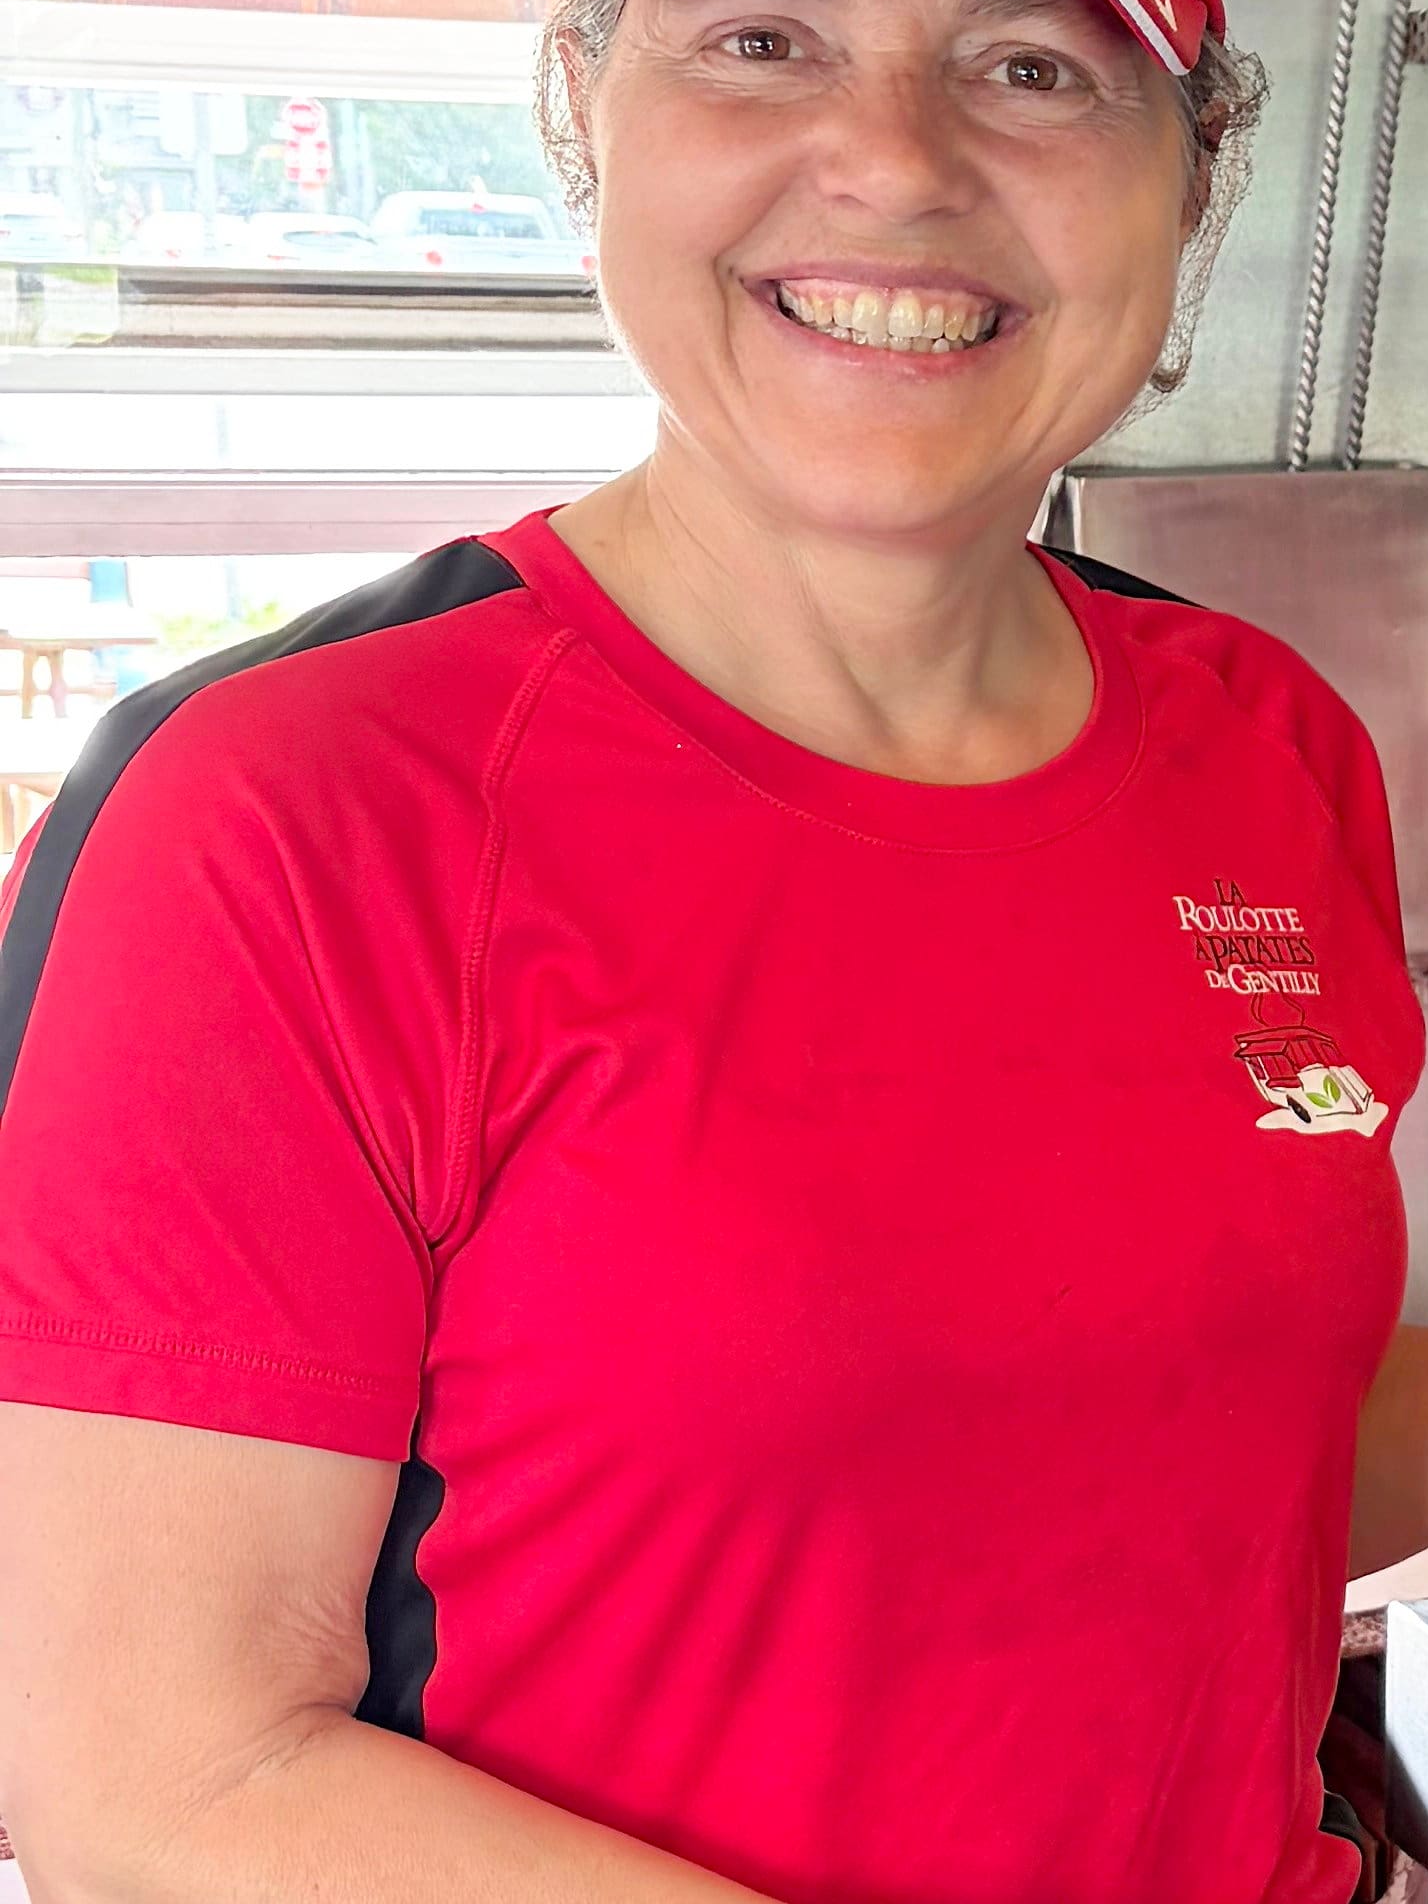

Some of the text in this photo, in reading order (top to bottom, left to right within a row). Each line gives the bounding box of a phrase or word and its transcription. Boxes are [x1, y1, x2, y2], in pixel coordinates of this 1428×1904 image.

[1213, 878, 1246, 906] LA
[1172, 895, 1304, 933] ROULOTTE
[1205, 935, 1315, 972] PATATES
